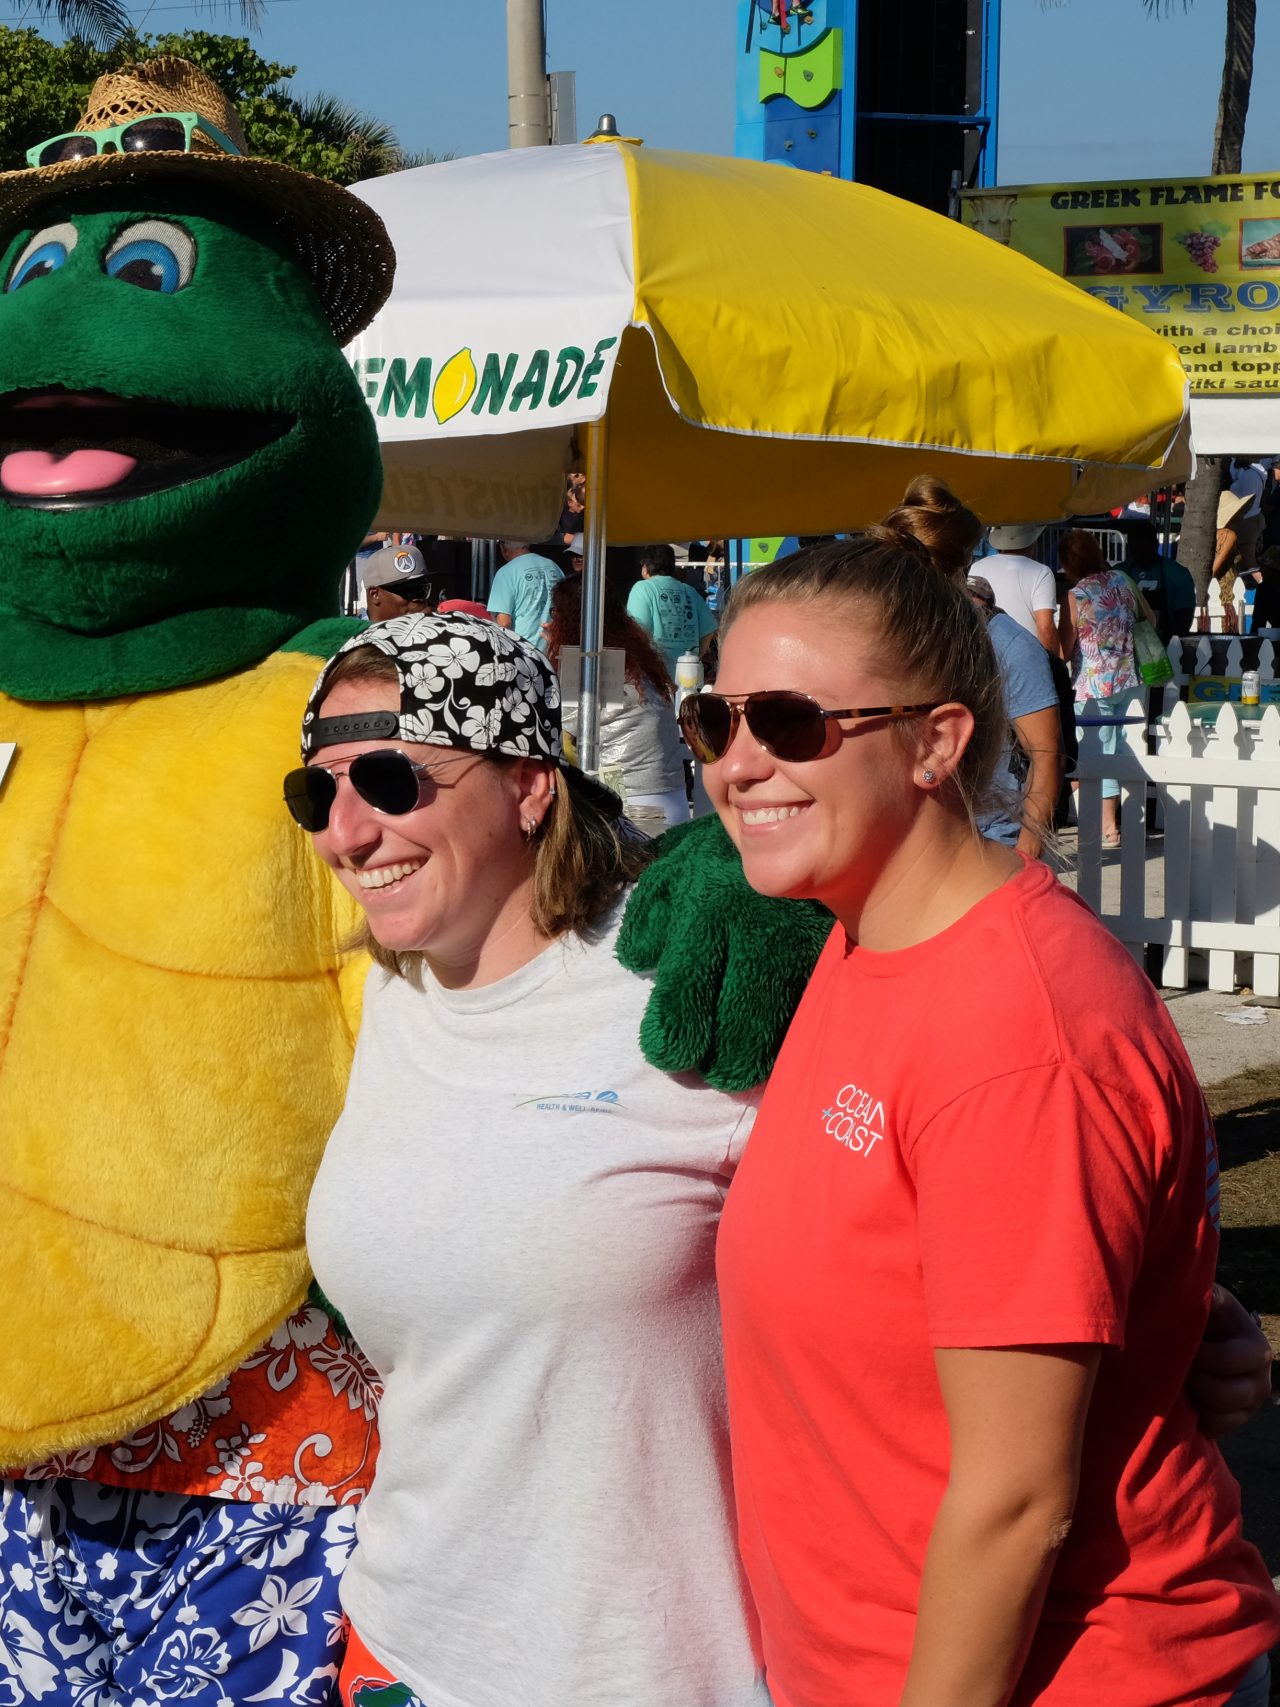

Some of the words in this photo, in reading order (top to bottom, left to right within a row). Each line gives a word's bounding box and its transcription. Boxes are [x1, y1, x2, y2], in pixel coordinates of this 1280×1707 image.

[1051, 187, 1141, 210] GREEK
[1150, 183, 1244, 206] FLAME
[1203, 326, 1217, 336] a
[1172, 342, 1206, 354] ed
[1215, 341, 1278, 354] lamb
[1183, 360, 1223, 373] and
[1234, 379, 1280, 389] sau
[537, 1103, 560, 1111] HEALTH
[836, 1083, 885, 1133] OCEAN
[825, 1111, 884, 1157] COAST
